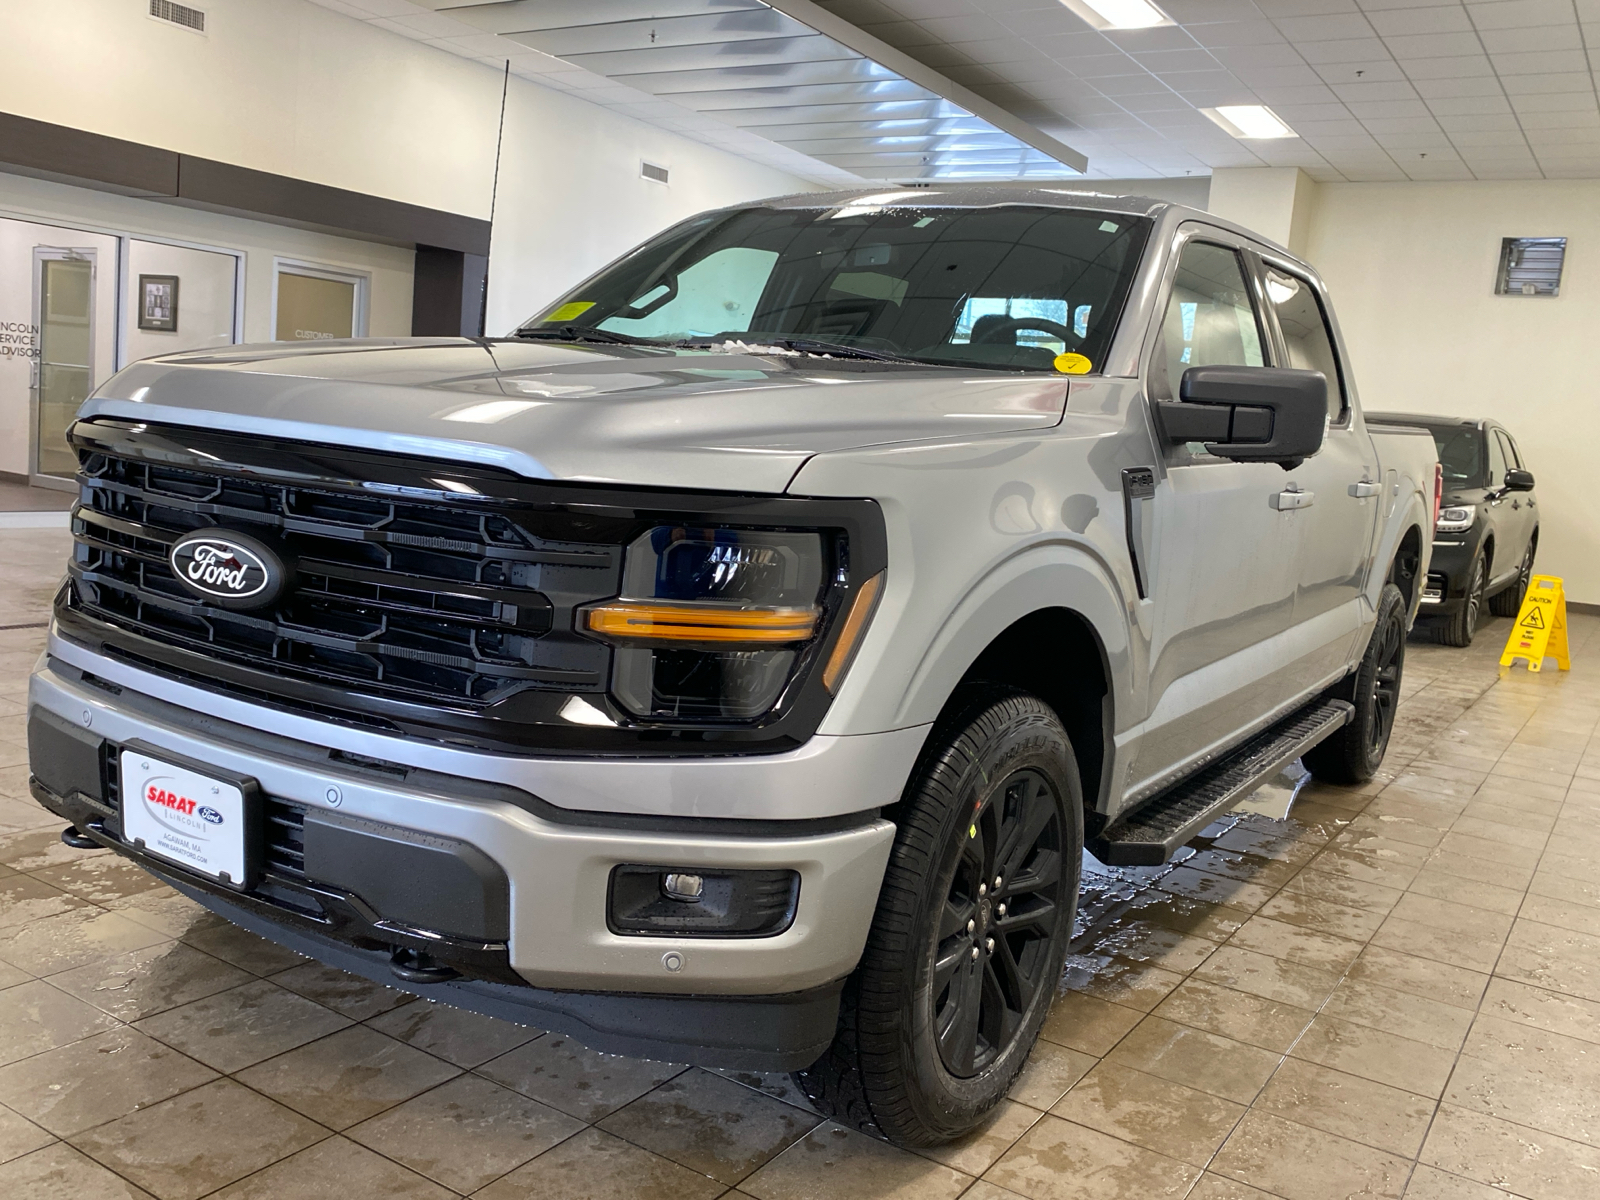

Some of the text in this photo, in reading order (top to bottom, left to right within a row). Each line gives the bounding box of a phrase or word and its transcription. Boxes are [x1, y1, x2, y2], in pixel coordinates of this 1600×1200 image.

[0, 322, 39, 335] NCOLN
[0, 333, 35, 346] ERVICE
[0, 345, 42, 358] DVISOR
[188, 545, 249, 590] Ford
[1529, 596, 1552, 604] CAUTION
[147, 785, 197, 816] SARAT
[169, 812, 201, 830] LINCOLN
[192, 843, 202, 853] MA
